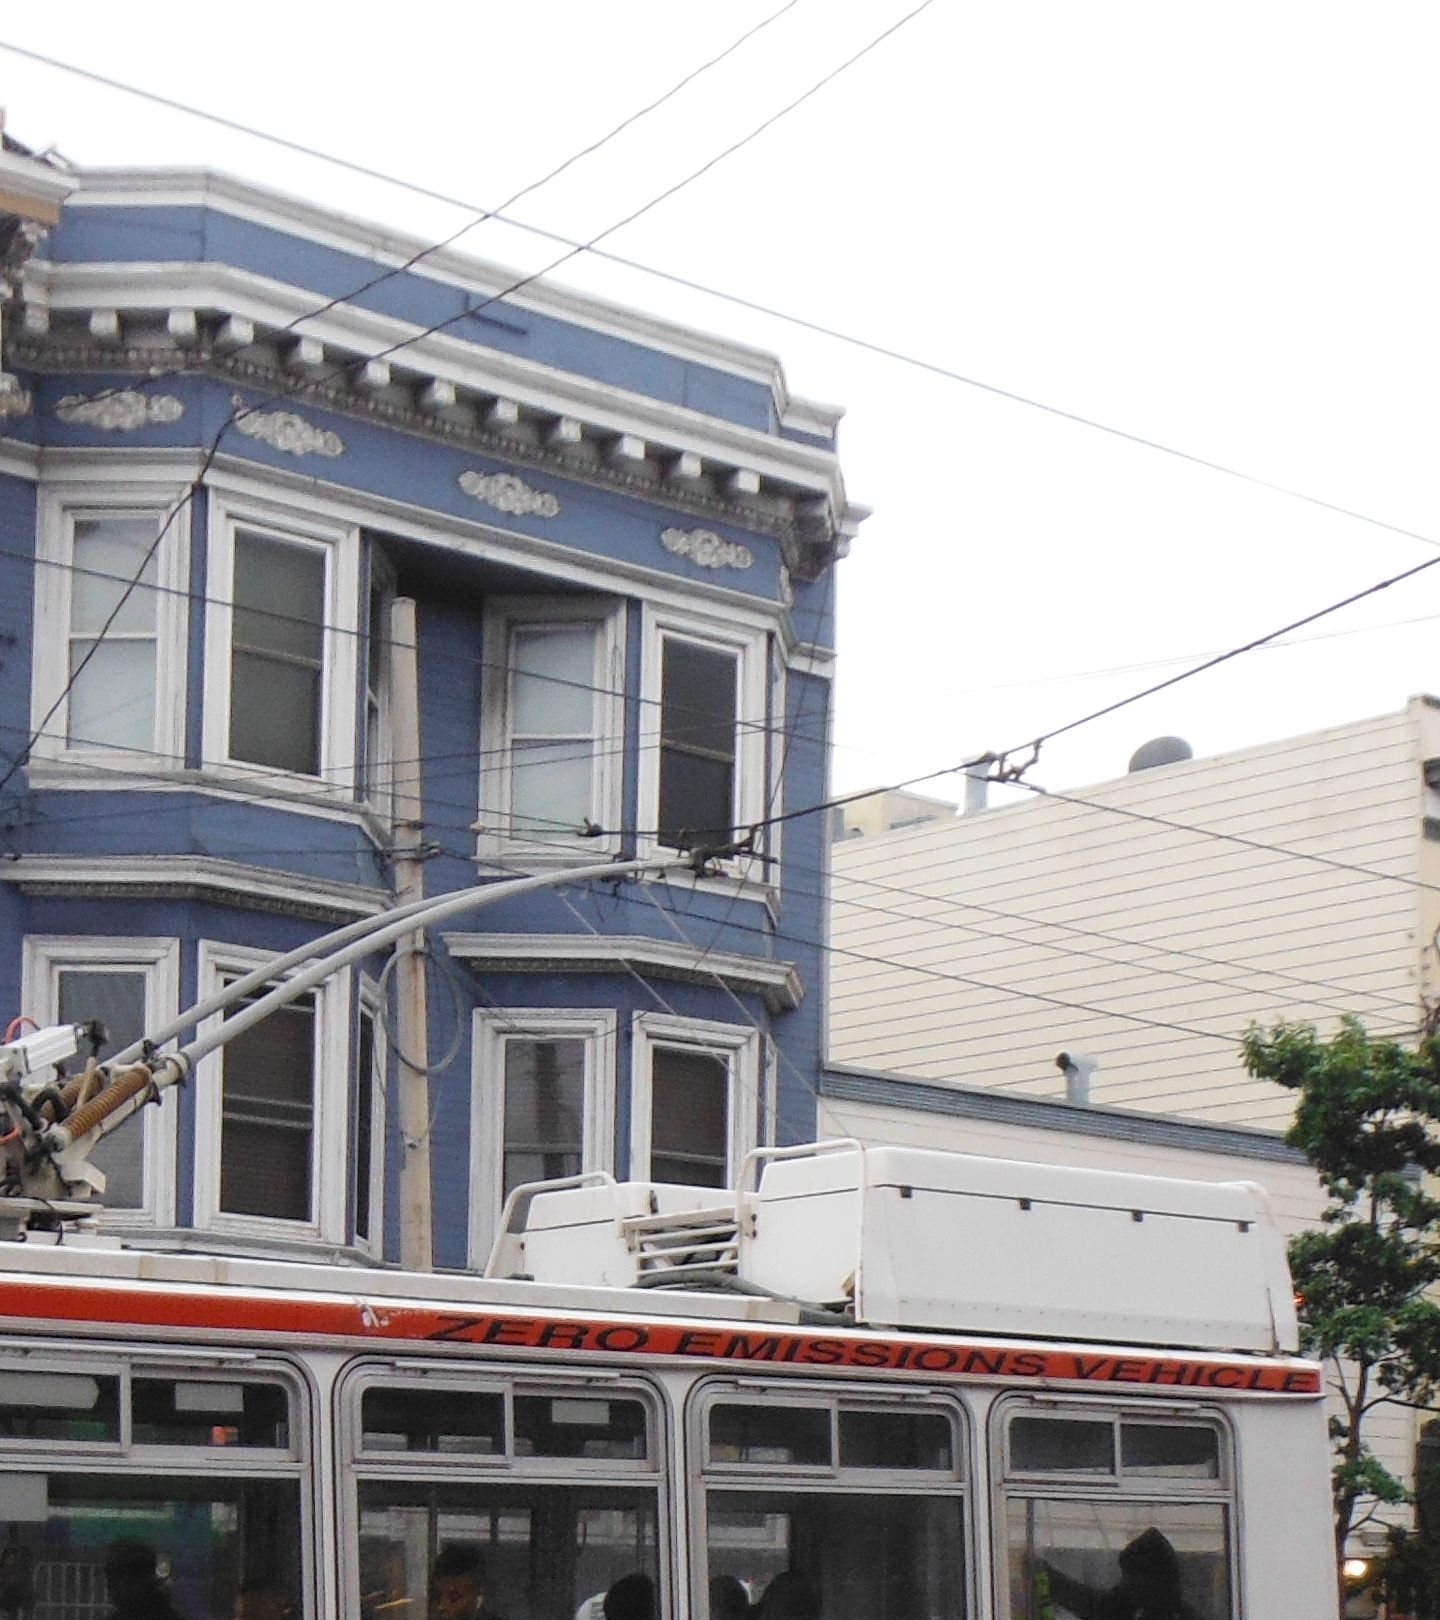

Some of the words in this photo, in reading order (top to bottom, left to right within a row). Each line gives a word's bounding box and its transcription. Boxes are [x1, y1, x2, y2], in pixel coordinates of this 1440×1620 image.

[426, 1314, 651, 1352] ZERO
[673, 1329, 1048, 1377] EMISSIONS
[1070, 1356, 1319, 1393] VEHICLE
